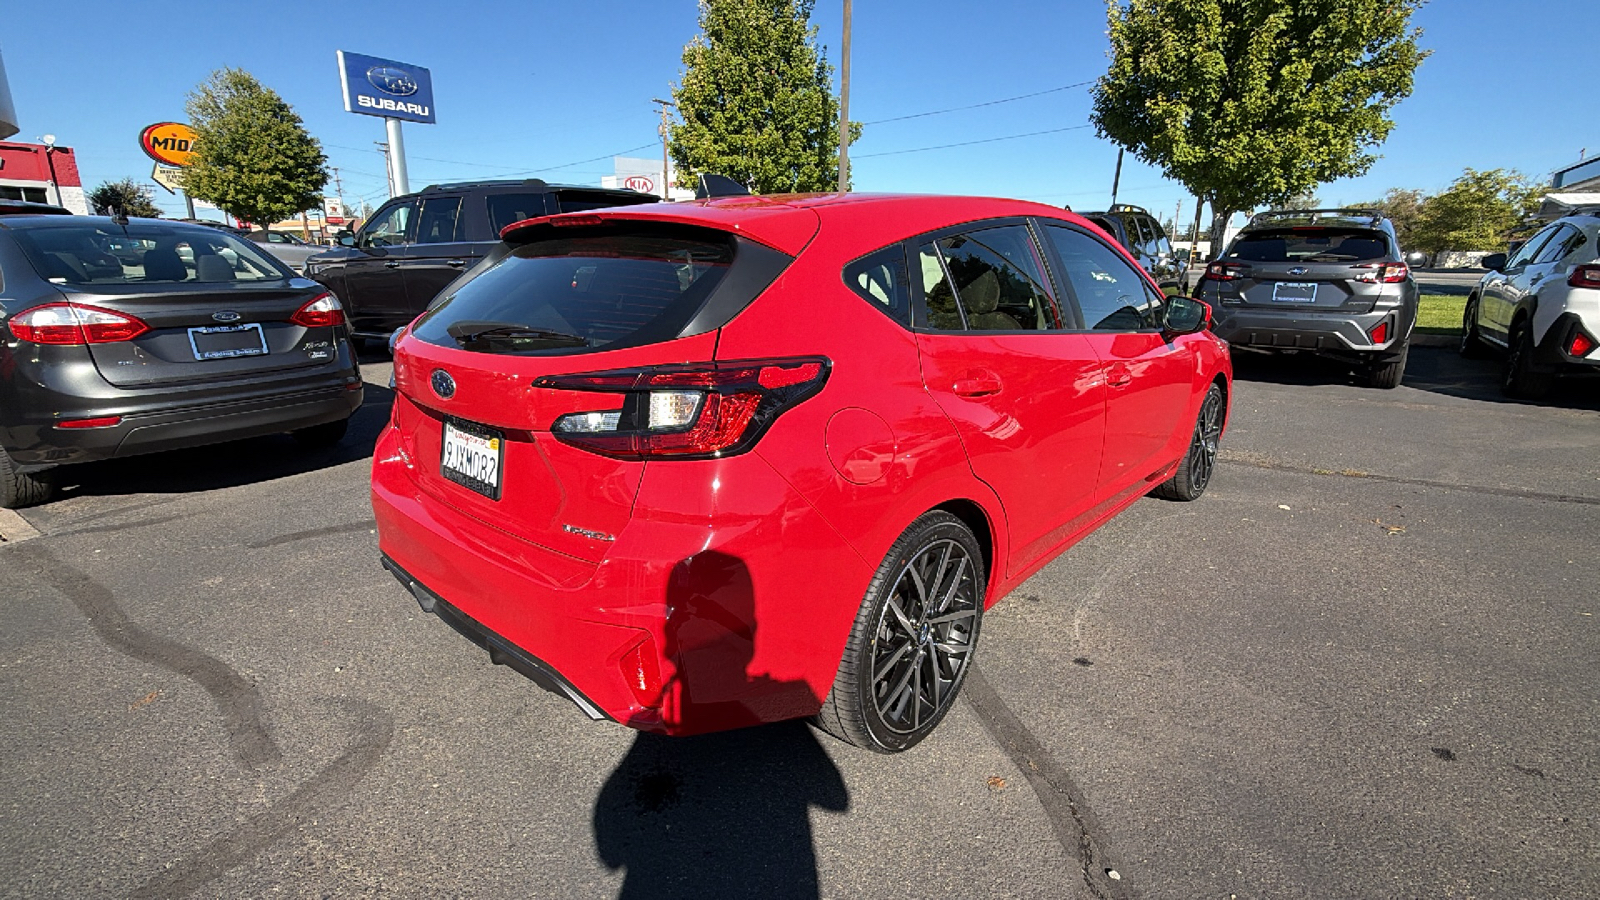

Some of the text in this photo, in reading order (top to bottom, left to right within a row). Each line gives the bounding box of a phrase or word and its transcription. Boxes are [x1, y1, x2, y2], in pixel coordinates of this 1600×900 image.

[357, 94, 429, 117] SUBARU
[151, 133, 193, 152] MID
[629, 179, 649, 191] KIA
[446, 441, 496, 483] 9JXM082
